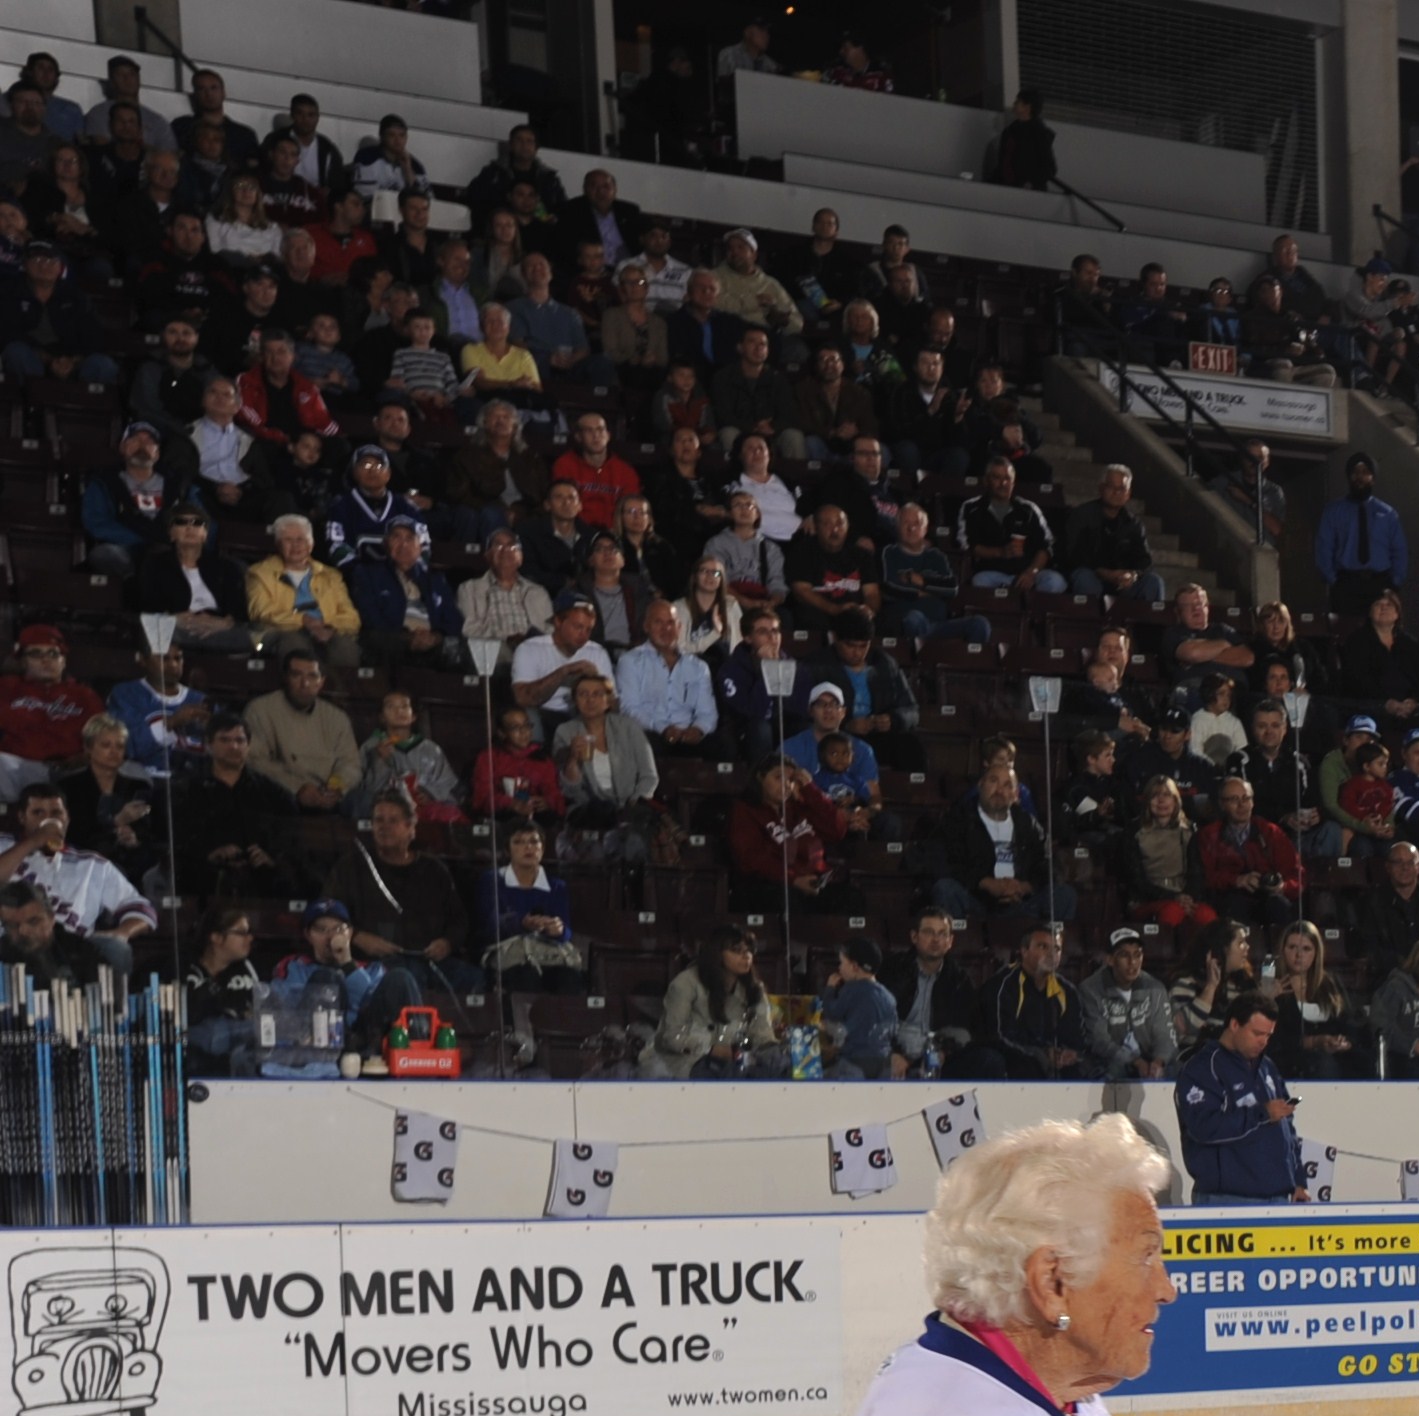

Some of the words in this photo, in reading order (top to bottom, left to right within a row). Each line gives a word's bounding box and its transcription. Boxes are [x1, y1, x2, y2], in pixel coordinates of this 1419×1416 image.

[1198, 346, 1231, 372] EXIT
[724, 677, 737, 698] 3
[1354, 1235, 1411, 1249] more
[187, 1271, 324, 1321] TWO
[341, 1269, 455, 1316] MEN
[472, 1266, 584, 1312] AND
[600, 1264, 636, 1307] A
[651, 1259, 807, 1306] TRUCK
[1216, 1311, 1243, 1319] VISIT
[490, 1323, 593, 1369] Who
[1338, 1353, 1378, 1376] GO
[667, 1386, 828, 1408] www.twomen.ca
